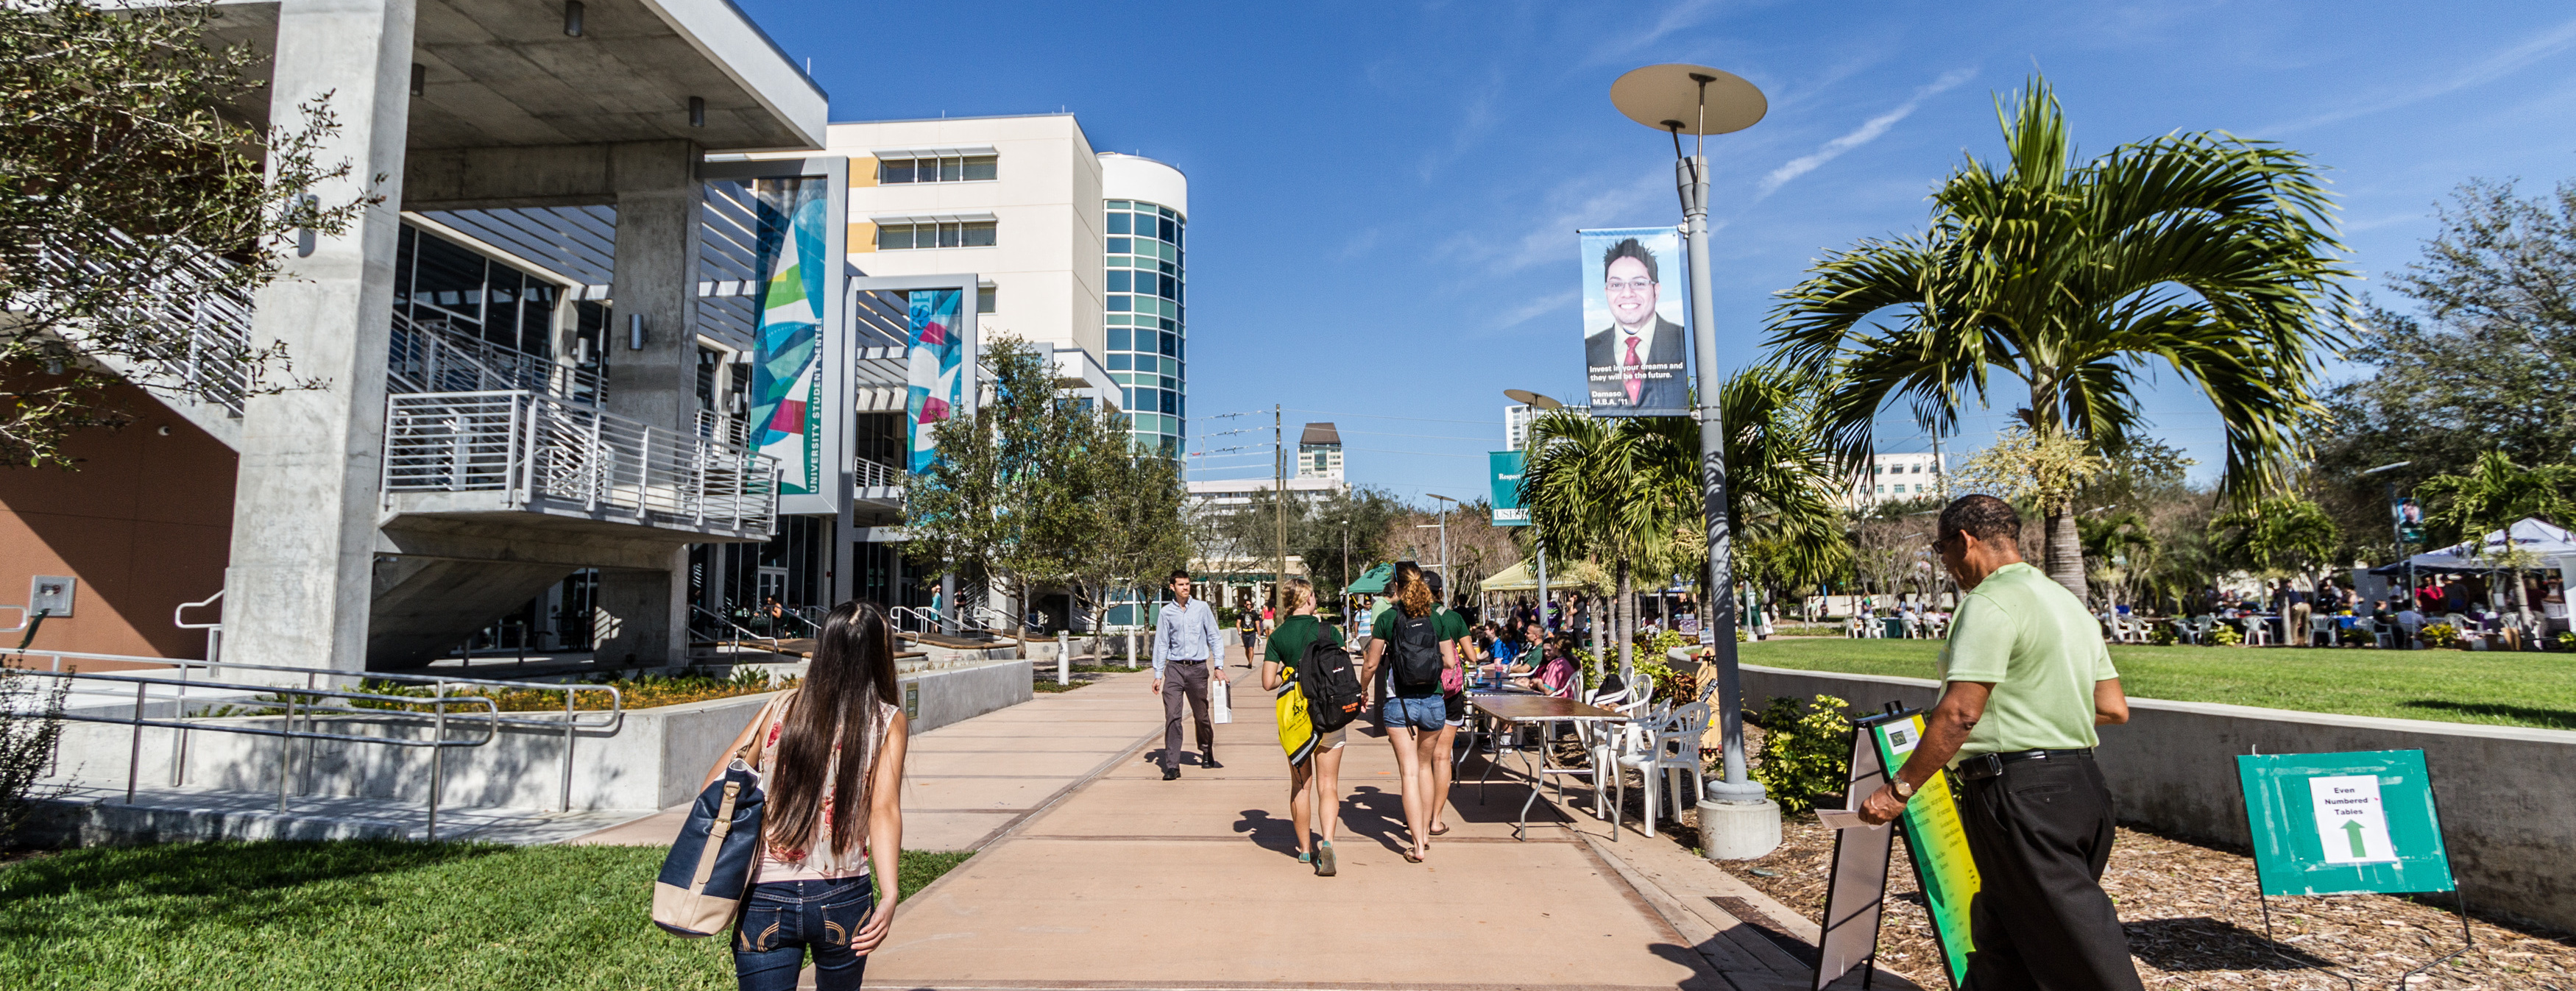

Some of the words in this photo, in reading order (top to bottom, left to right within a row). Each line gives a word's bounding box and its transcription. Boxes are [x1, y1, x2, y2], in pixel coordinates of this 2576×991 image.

[812, 368, 821, 419] STUDENT
[1590, 374, 1607, 382] they
[810, 424, 820, 493] UNIVERSITY
